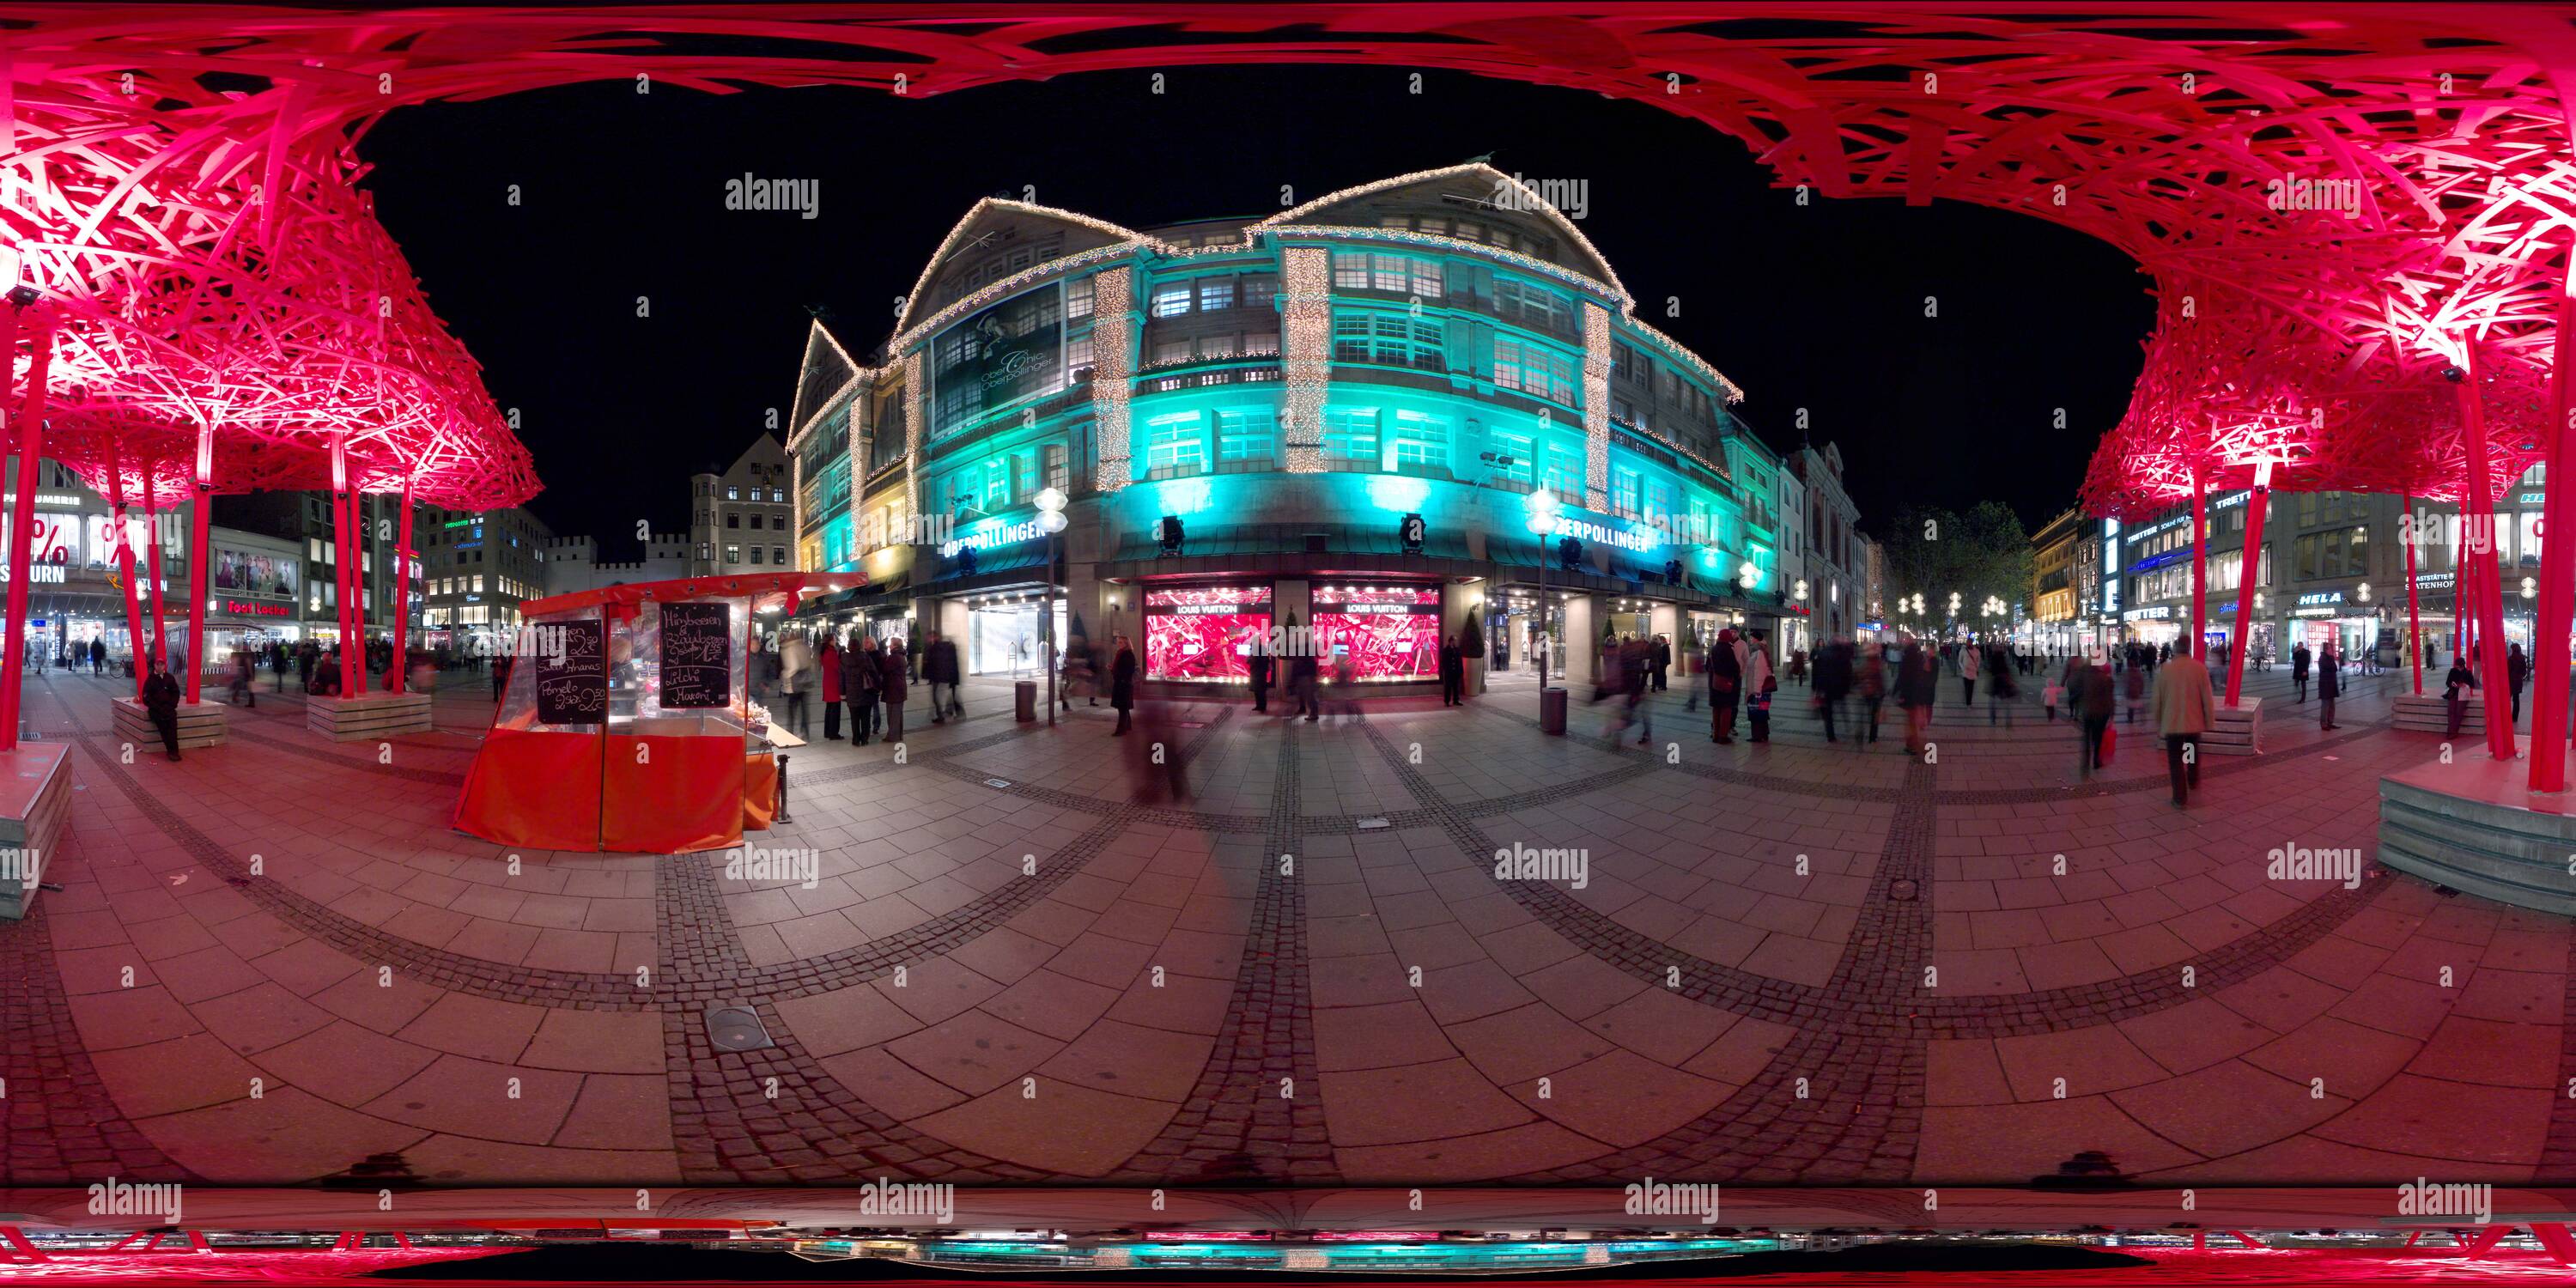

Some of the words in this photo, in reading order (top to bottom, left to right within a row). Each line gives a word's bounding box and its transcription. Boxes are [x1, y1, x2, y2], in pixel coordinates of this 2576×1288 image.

[981, 356, 1054, 392] Oberpollinger
[1555, 516, 1648, 554] BERPOLLINGER
[2127, 526, 2158, 544] TRETTER
[0, 565, 65, 584] SURN
[2406, 573, 2448, 582] ASTSTÄTTE
[2405, 580, 2456, 591] SATENHOF
[2300, 592, 2342, 605] HELA
[228, 601, 253, 614] Foot
[1178, 605, 1199, 614] LOUIS
[1201, 605, 1238, 614] VUITTON
[1346, 605, 1371, 613] LOUIS
[1372, 605, 1408, 613] VUITTON
[2123, 606, 2169, 622] TRTTER
[538, 679, 578, 697] Pomelo
